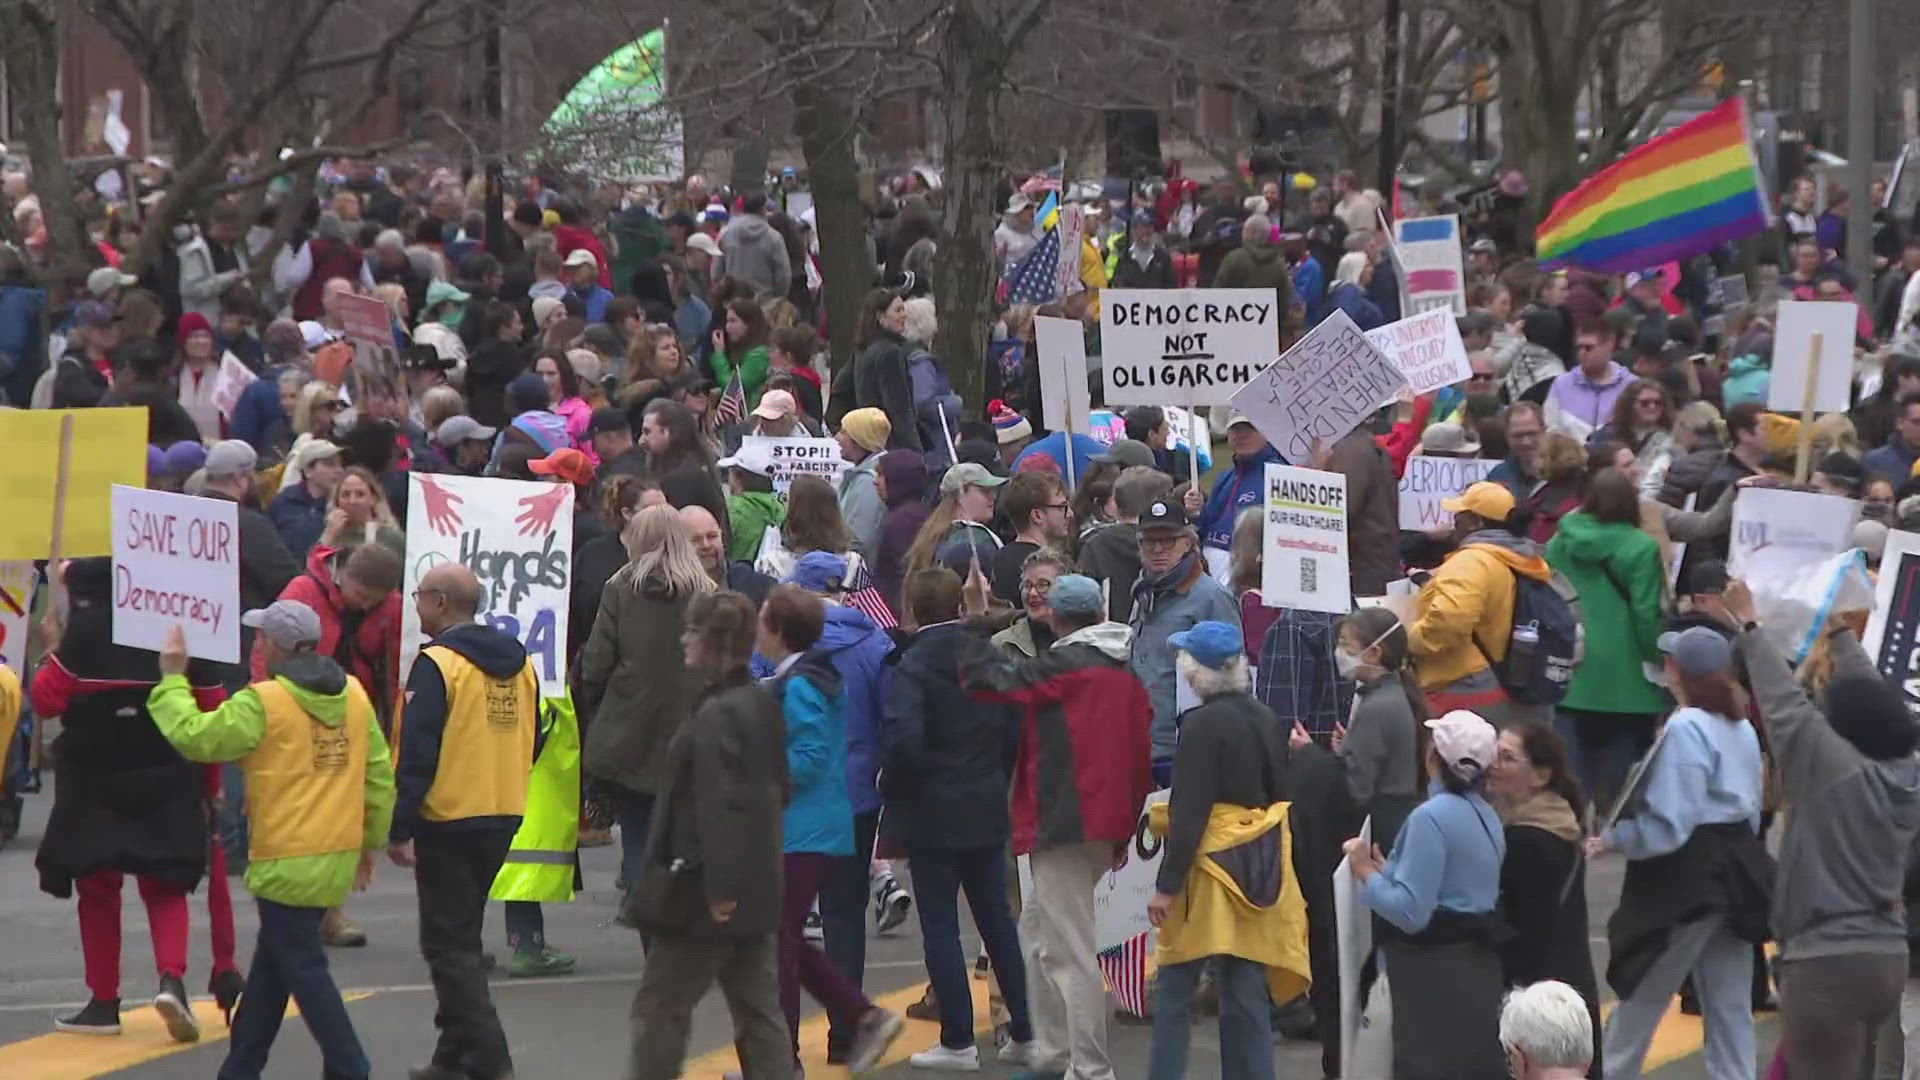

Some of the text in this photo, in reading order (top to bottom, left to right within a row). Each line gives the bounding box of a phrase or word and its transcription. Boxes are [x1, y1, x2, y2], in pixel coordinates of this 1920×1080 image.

[1112, 303, 1269, 326] DEMOCRACY
[1165, 333, 1207, 354] NOT
[1288, 327, 1362, 394] BECOME
[1286, 341, 1379, 426] EMPATHY
[1289, 361, 1403, 456] WHEN DID
[773, 446, 830, 458] STOP!!
[790, 462, 838, 472] FASCIST
[1270, 478, 1343, 507] HANDS OFF
[126, 507, 231, 564] SAVE OUR
[1270, 510, 1288, 524] OUR
[459, 528, 568, 589] Hands
[116, 564, 224, 634] Democracy
